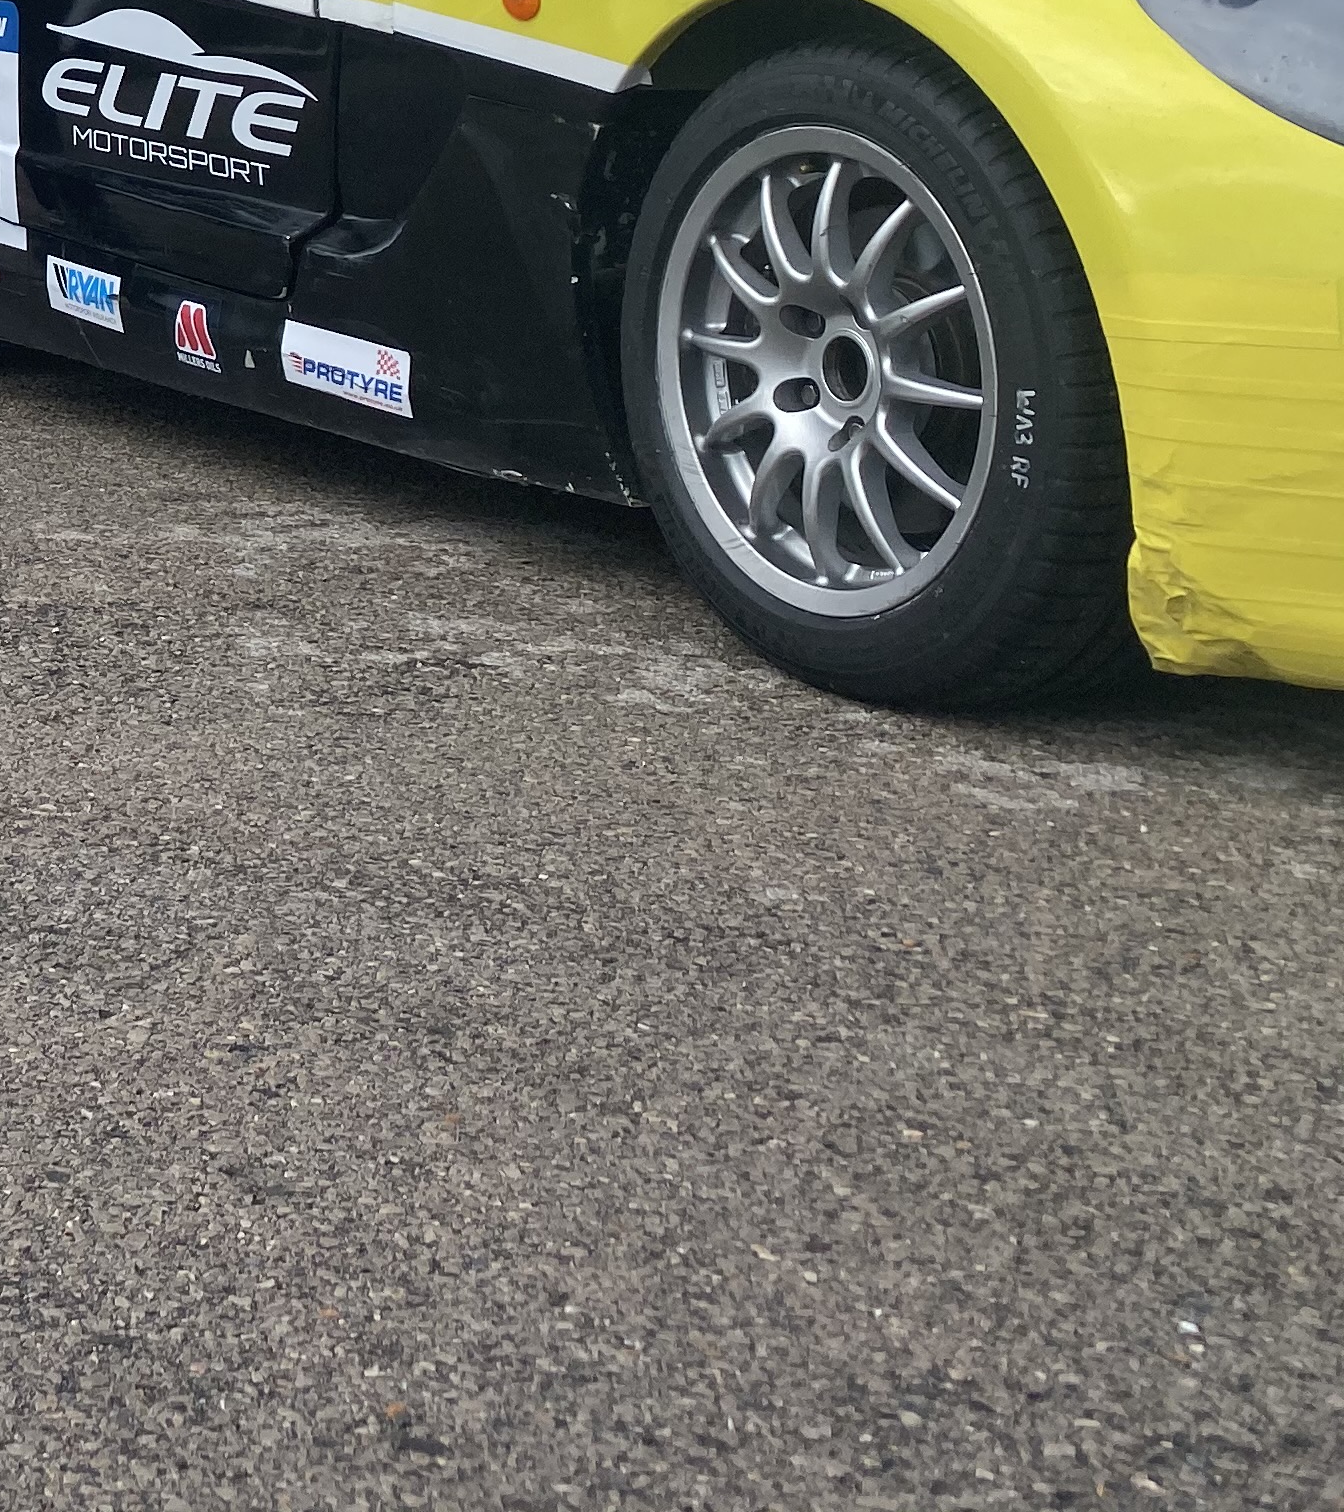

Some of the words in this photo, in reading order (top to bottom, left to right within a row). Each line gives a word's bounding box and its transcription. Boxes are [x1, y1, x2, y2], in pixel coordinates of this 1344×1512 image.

[41, 57, 306, 157] ELITE
[72, 124, 271, 186] MOTORSPORT
[67, 268, 115, 315] RYAN
[302, 357, 404, 404] PROTYRE
[1011, 455, 1031, 489] RF
